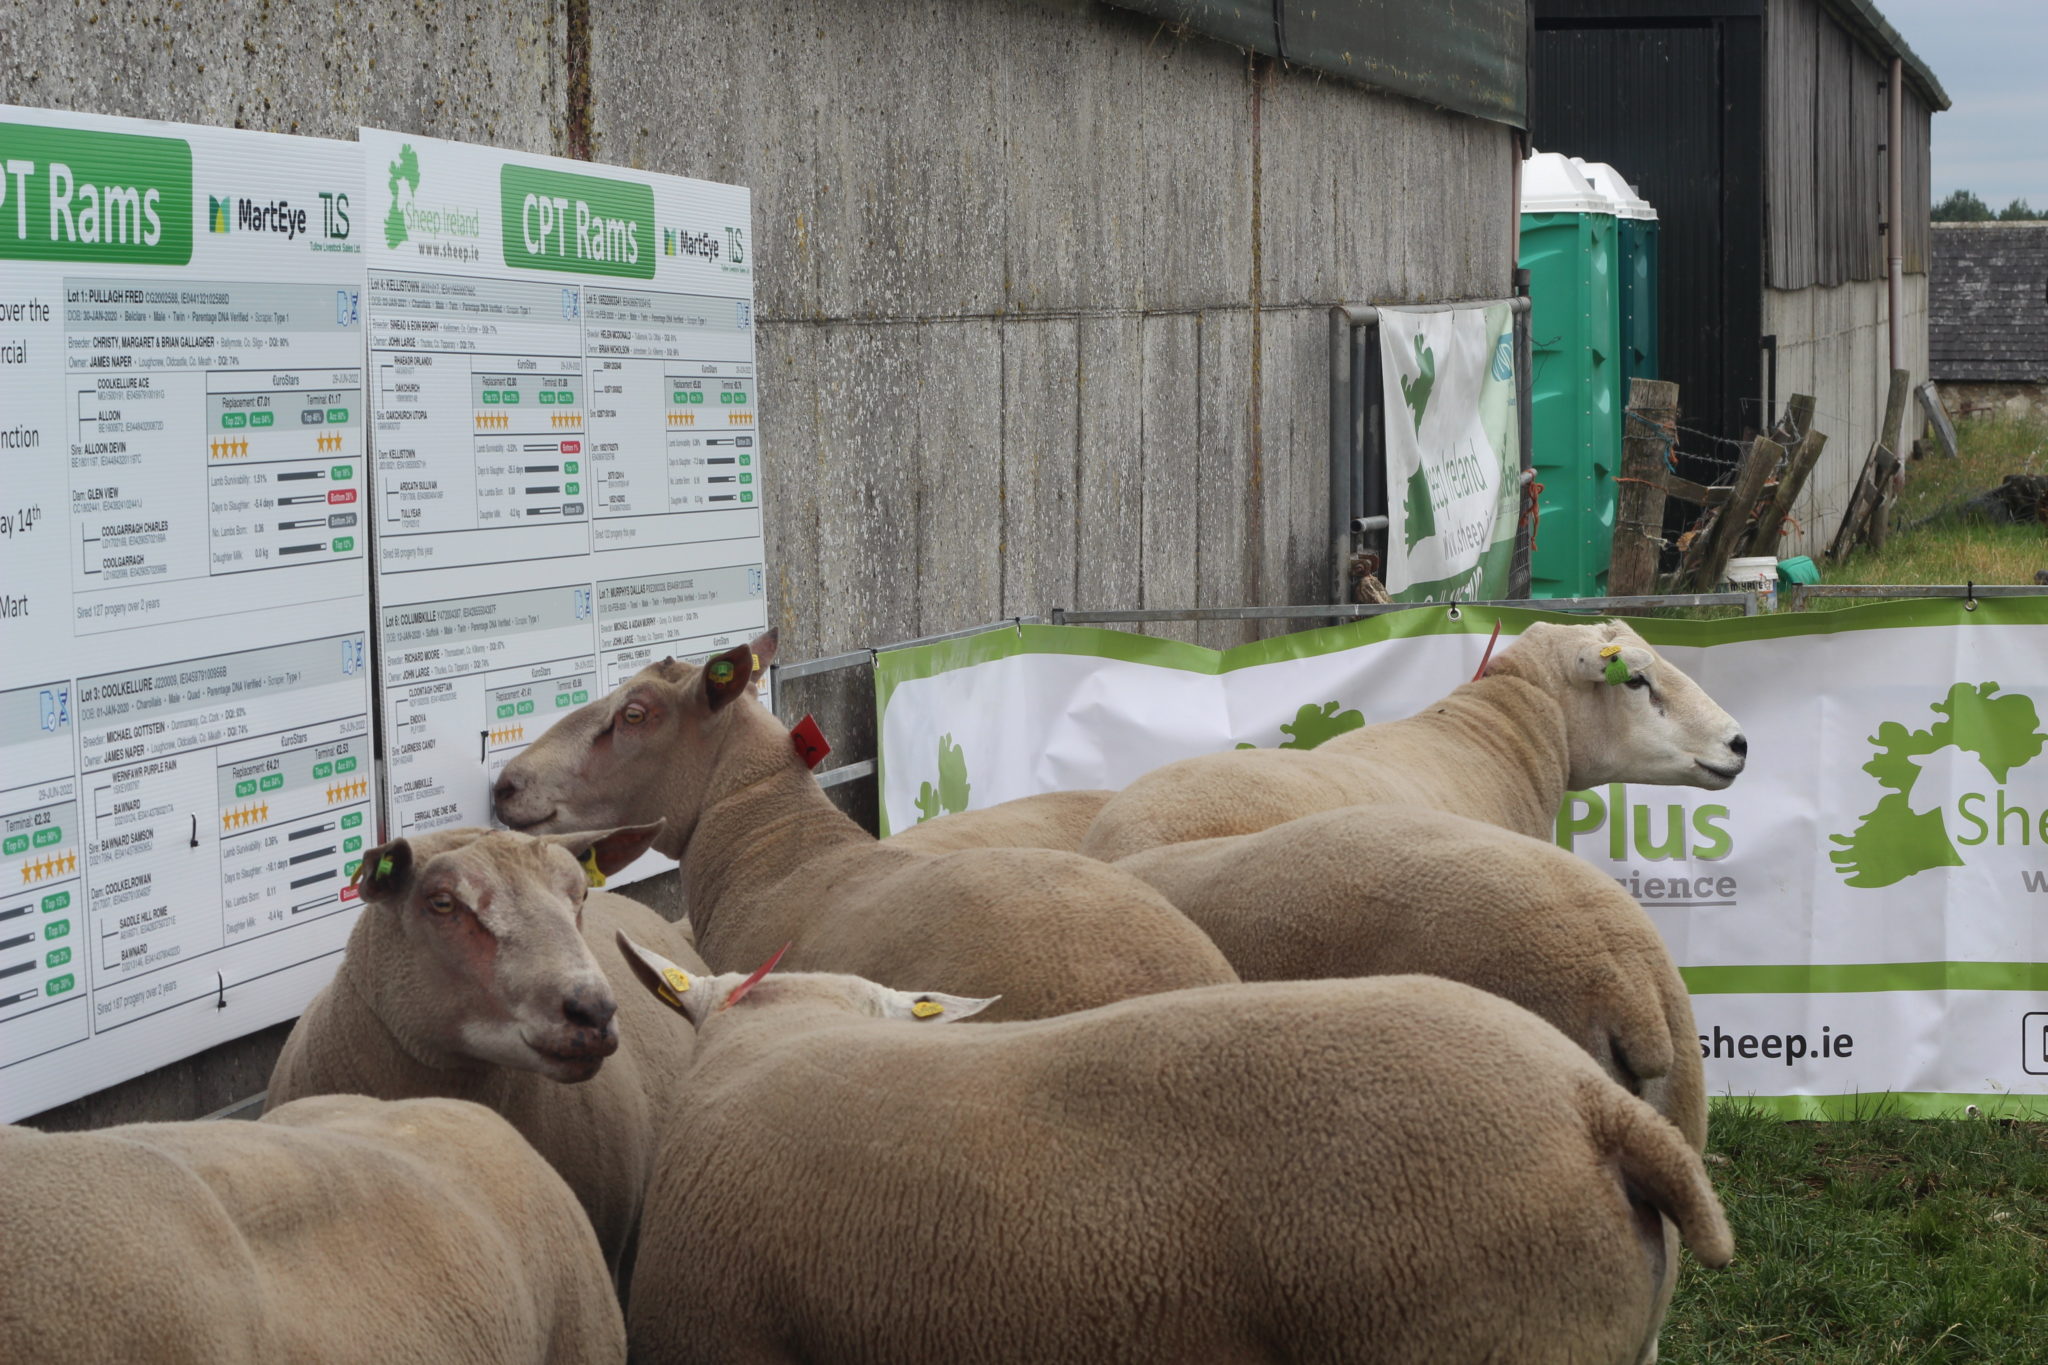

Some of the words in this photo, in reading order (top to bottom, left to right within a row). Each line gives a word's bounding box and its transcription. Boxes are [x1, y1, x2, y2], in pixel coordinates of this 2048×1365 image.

[49, 162, 161, 246] Rams
[239, 197, 306, 240] MartEye
[319, 192, 350, 239] TLS
[406, 201, 440, 239] Sheep
[444, 206, 479, 238] Ireland
[522, 193, 568, 256] CPT
[576, 200, 638, 264] Rams
[418, 242, 479, 263] www.sheep.ie
[680, 230, 719, 263] MartEye
[725, 226, 744, 264] TLS
[68, 289, 79, 302] Lot
[89, 290, 124, 303] PULLAGH
[125, 290, 143, 303] FRED
[0, 304, 25, 321] over
[29, 297, 49, 321] the
[125, 311, 146, 321] Belclare
[154, 312, 165, 321] Male
[173, 312, 185, 321] Twin
[192, 312, 217, 324] Parentage
[218, 313, 228, 322] DNA
[230, 313, 248, 322] Verified
[274, 313, 286, 324] Type
[122, 337, 154, 348] MARGARET
[162, 337, 179, 348] BRIAN
[180, 337, 214, 348] GALLAGHER
[388, 337, 401, 347] JOHN
[401, 338, 416, 348] LARGE
[90, 356, 110, 367] JAMES
[112, 356, 132, 367] NAPER
[98, 378, 137, 388] COOLKELLURE
[139, 378, 149, 388] ACE
[99, 410, 120, 421] ALLOON
[84, 443, 108, 454] ALLOON
[110, 442, 126, 453] DEVIN
[88, 488, 104, 500] GLEN
[105, 487, 118, 499] VIEW
[144, 521, 168, 533] CHARLES
[0, 594, 28, 619] Mart
[77, 606, 92, 619] Sired
[94, 604, 103, 615] 127
[105, 603, 126, 617] progeny
[128, 602, 140, 612] over
[146, 599, 160, 612] years
[385, 616, 394, 627] Lot
[404, 652, 424, 664] RICHARD
[425, 649, 440, 661] MOORE
[403, 670, 414, 680] JOHN
[415, 667, 430, 677] LARGE
[81, 688, 92, 702] Lot
[94, 686, 100, 700] 3:
[102, 677, 152, 698] COOLKELLURE
[136, 697, 162, 710] Charollais
[169, 694, 180, 704] Male
[187, 691, 200, 701] Quad
[207, 685, 231, 697] Parentage
[232, 682, 243, 692] DNA
[244, 680, 262, 690] Verified
[286, 673, 297, 684] Type
[106, 728, 133, 744] MICHAEL
[134, 721, 165, 737] GOTTSTEIN
[104, 748, 124, 763] JAMES
[125, 744, 144, 759] NAPER
[143, 762, 163, 777] PURPLE
[164, 760, 177, 771] RAIN
[114, 799, 141, 814] BAWNARD
[432, 808, 440, 817] ONE
[449, 803, 457, 813] ONE
[34, 811, 51, 827] €2.32
[1555, 782, 1734, 862] Plus
[6, 840, 17, 853] Top
[101, 835, 130, 851] BAWNARD
[130, 829, 153, 843] SAMSON
[45, 897, 56, 909] Top
[119, 914, 140, 929] SADDLE
[141, 910, 152, 921] HILL
[153, 906, 168, 918] ROME
[48, 925, 59, 937] Top
[49, 952, 60, 965] Top
[121, 943, 148, 961] BAWNARD
[49, 979, 60, 992] Top
[123, 994, 145, 1008] progeny
[146, 990, 157, 1000] over
[163, 981, 177, 996] years
[1699, 1025, 1854, 1066] sheep.ie
